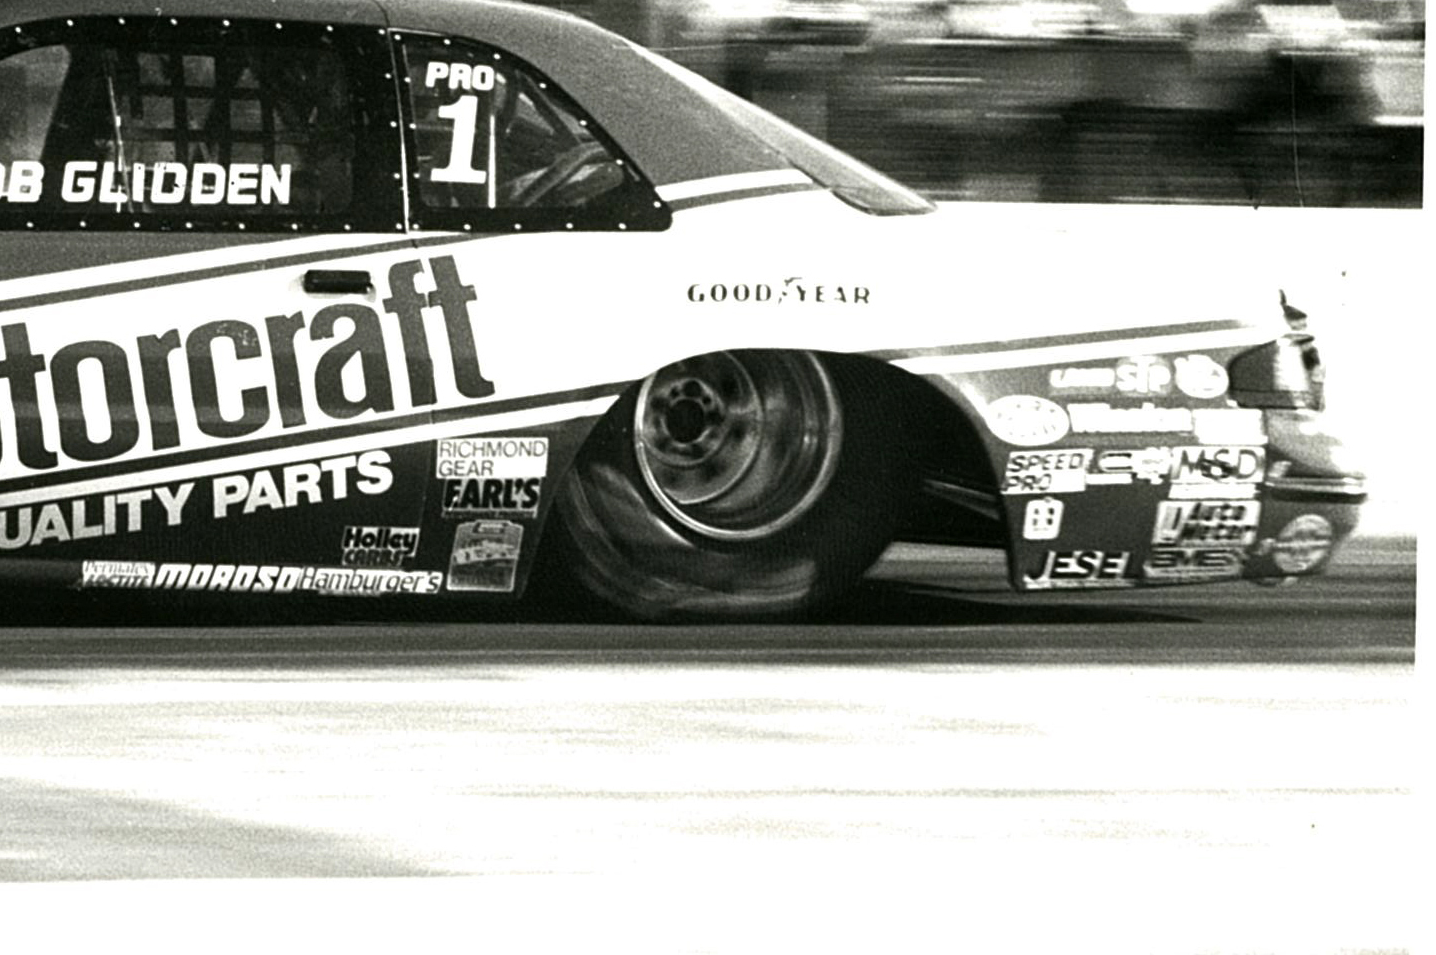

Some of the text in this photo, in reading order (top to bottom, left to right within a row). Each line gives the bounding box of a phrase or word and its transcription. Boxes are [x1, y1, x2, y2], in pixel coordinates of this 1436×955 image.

[426, 62, 495, 91] PRO
[430, 96, 487, 184] 1
[61, 161, 292, 205] GLIDDEN
[438, 440, 547, 458] RICHMOND
[1008, 452, 1085, 473] SPEED
[438, 459, 495, 477] GEAR
[212, 450, 394, 519] PARTS
[443, 478, 541, 509] EARL'S
[1002, 473, 1052, 492] PRO
[343, 527, 418, 555] Holley
[156, 563, 302, 592] MOROSO
[300, 567, 442, 595] Hamburger's
